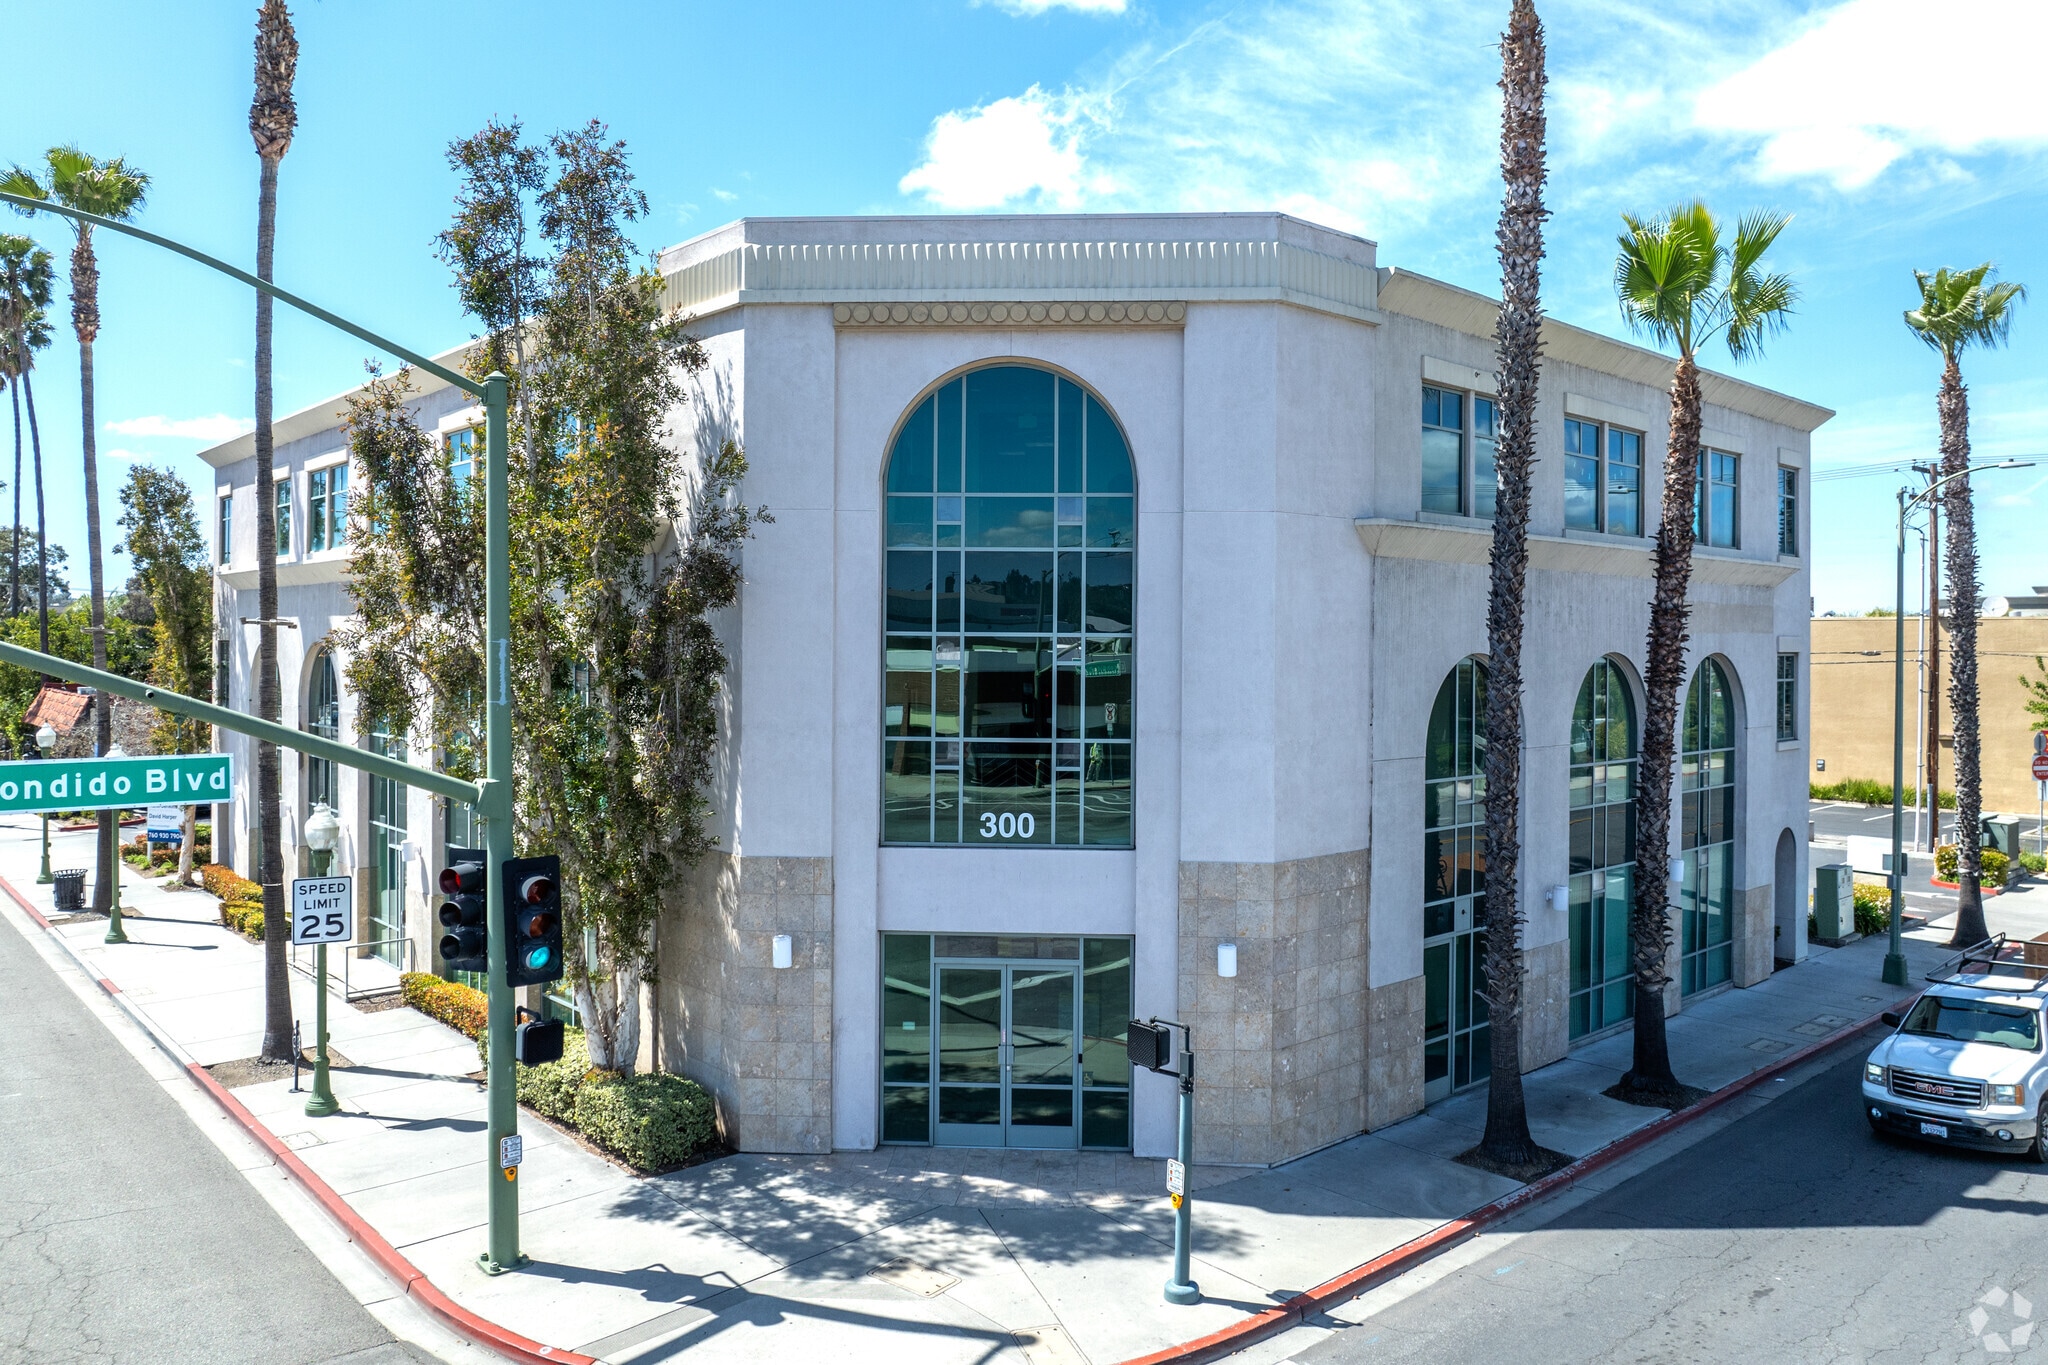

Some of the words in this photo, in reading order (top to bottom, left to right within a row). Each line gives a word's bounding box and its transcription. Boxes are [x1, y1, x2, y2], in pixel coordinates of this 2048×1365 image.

[0, 771, 131, 801] ondido
[145, 766, 225, 794] Blvd
[980, 812, 1035, 838] 300
[299, 883, 346, 895] SPEED
[304, 898, 340, 910] LIMIT
[300, 913, 344, 939] 25
[1915, 1082, 1954, 1097] GMC
